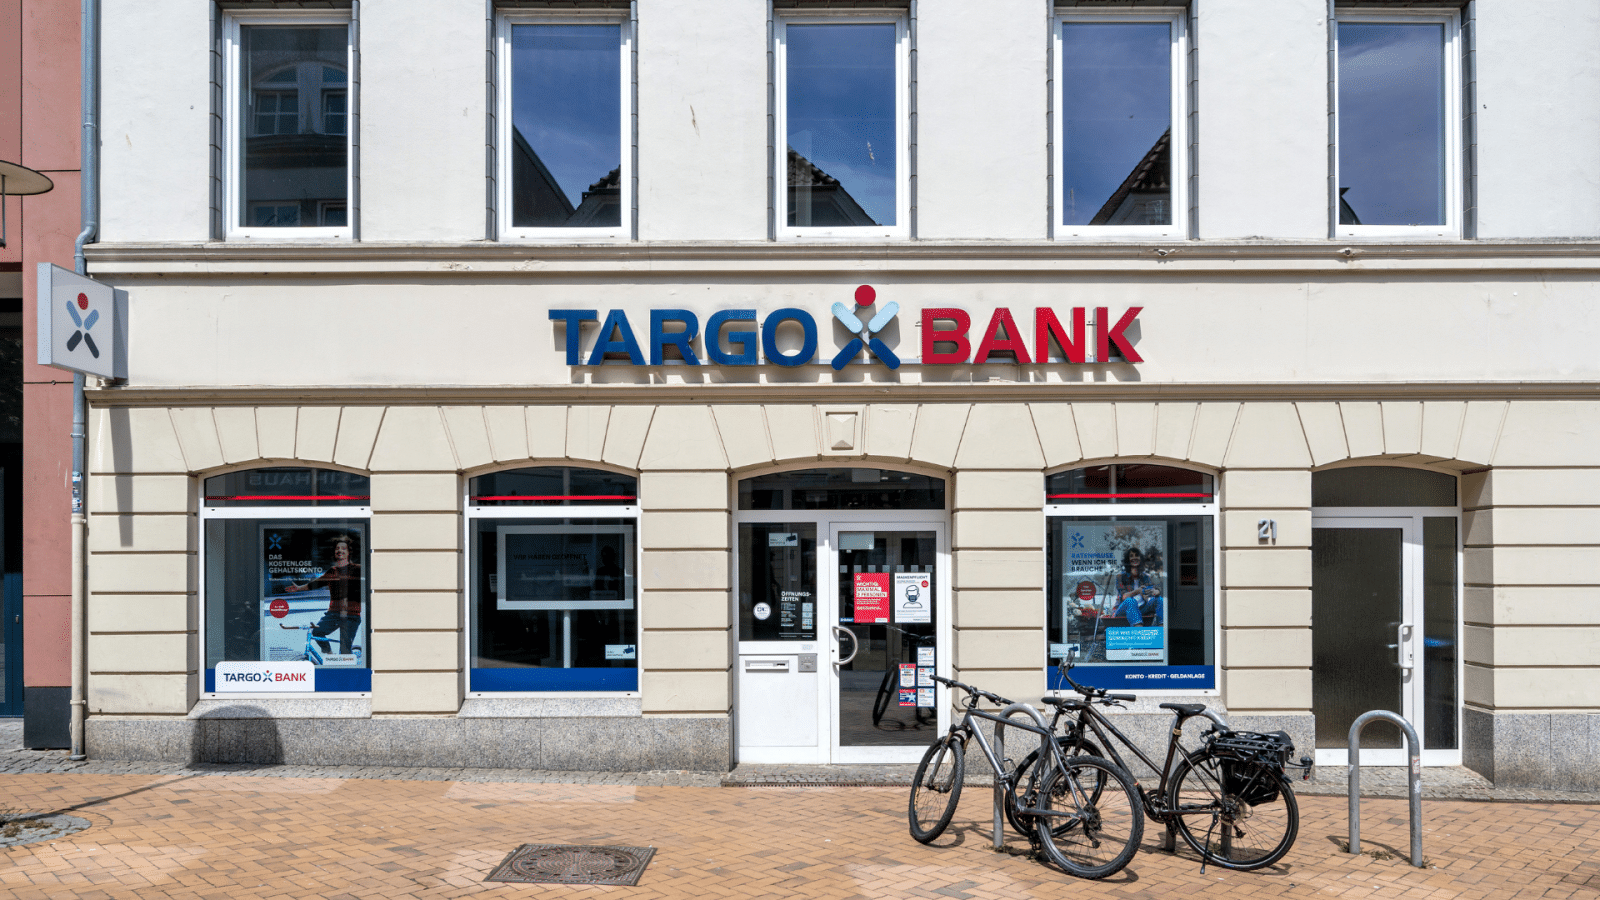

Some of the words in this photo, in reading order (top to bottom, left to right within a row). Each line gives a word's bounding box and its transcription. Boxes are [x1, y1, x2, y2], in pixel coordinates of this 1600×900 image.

[548, 307, 818, 366] TARGO
[921, 306, 1145, 365] BANK
[1257, 518, 1277, 539] 21
[268, 566, 323, 574] GEHALTSKONTO
[223, 672, 262, 682] TARGO
[275, 672, 307, 682] BANK
